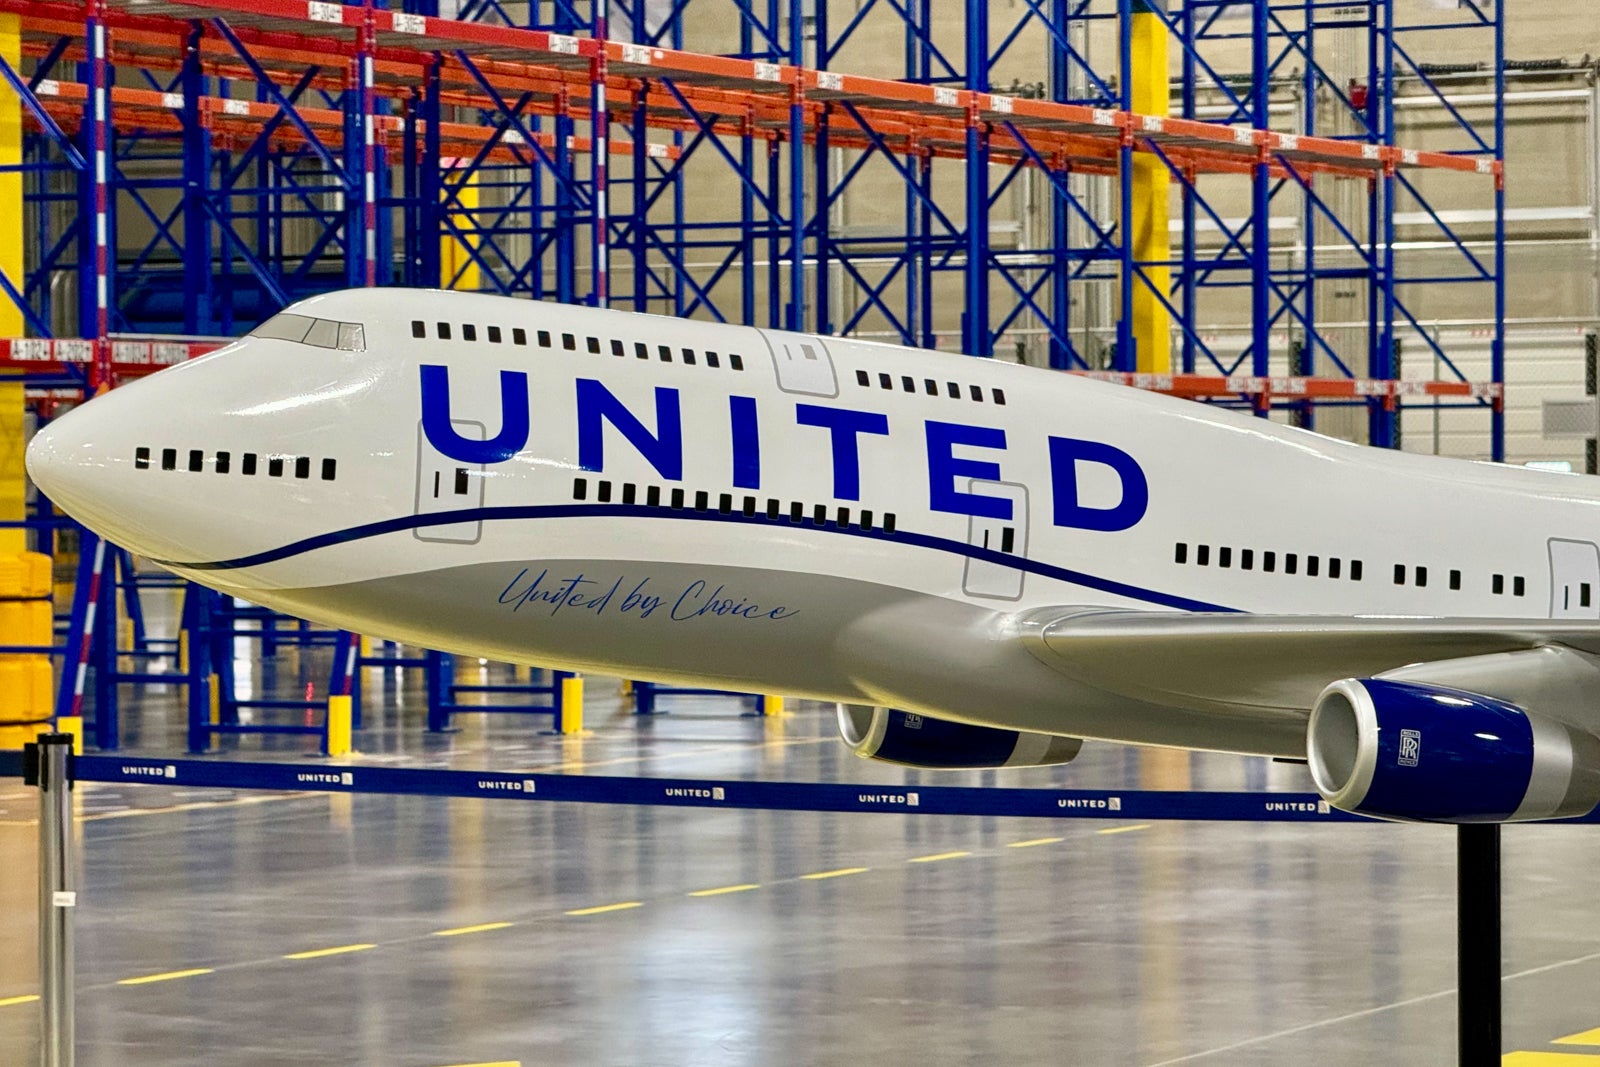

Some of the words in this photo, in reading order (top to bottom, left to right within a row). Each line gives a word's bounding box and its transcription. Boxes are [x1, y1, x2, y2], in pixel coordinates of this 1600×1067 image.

[420, 364, 1148, 532] UNITED
[498, 568, 624, 616] United
[620, 577, 666, 619] by
[670, 580, 800, 621] Choice
[122, 766, 164, 776] UNITED
[297, 773, 340, 783] UNITED
[478, 781, 522, 790] UNITED
[665, 788, 711, 798] UNITED
[858, 794, 906, 804] UNITED
[1057, 799, 1107, 808] UNITED
[1265, 802, 1316, 812] UNITED
